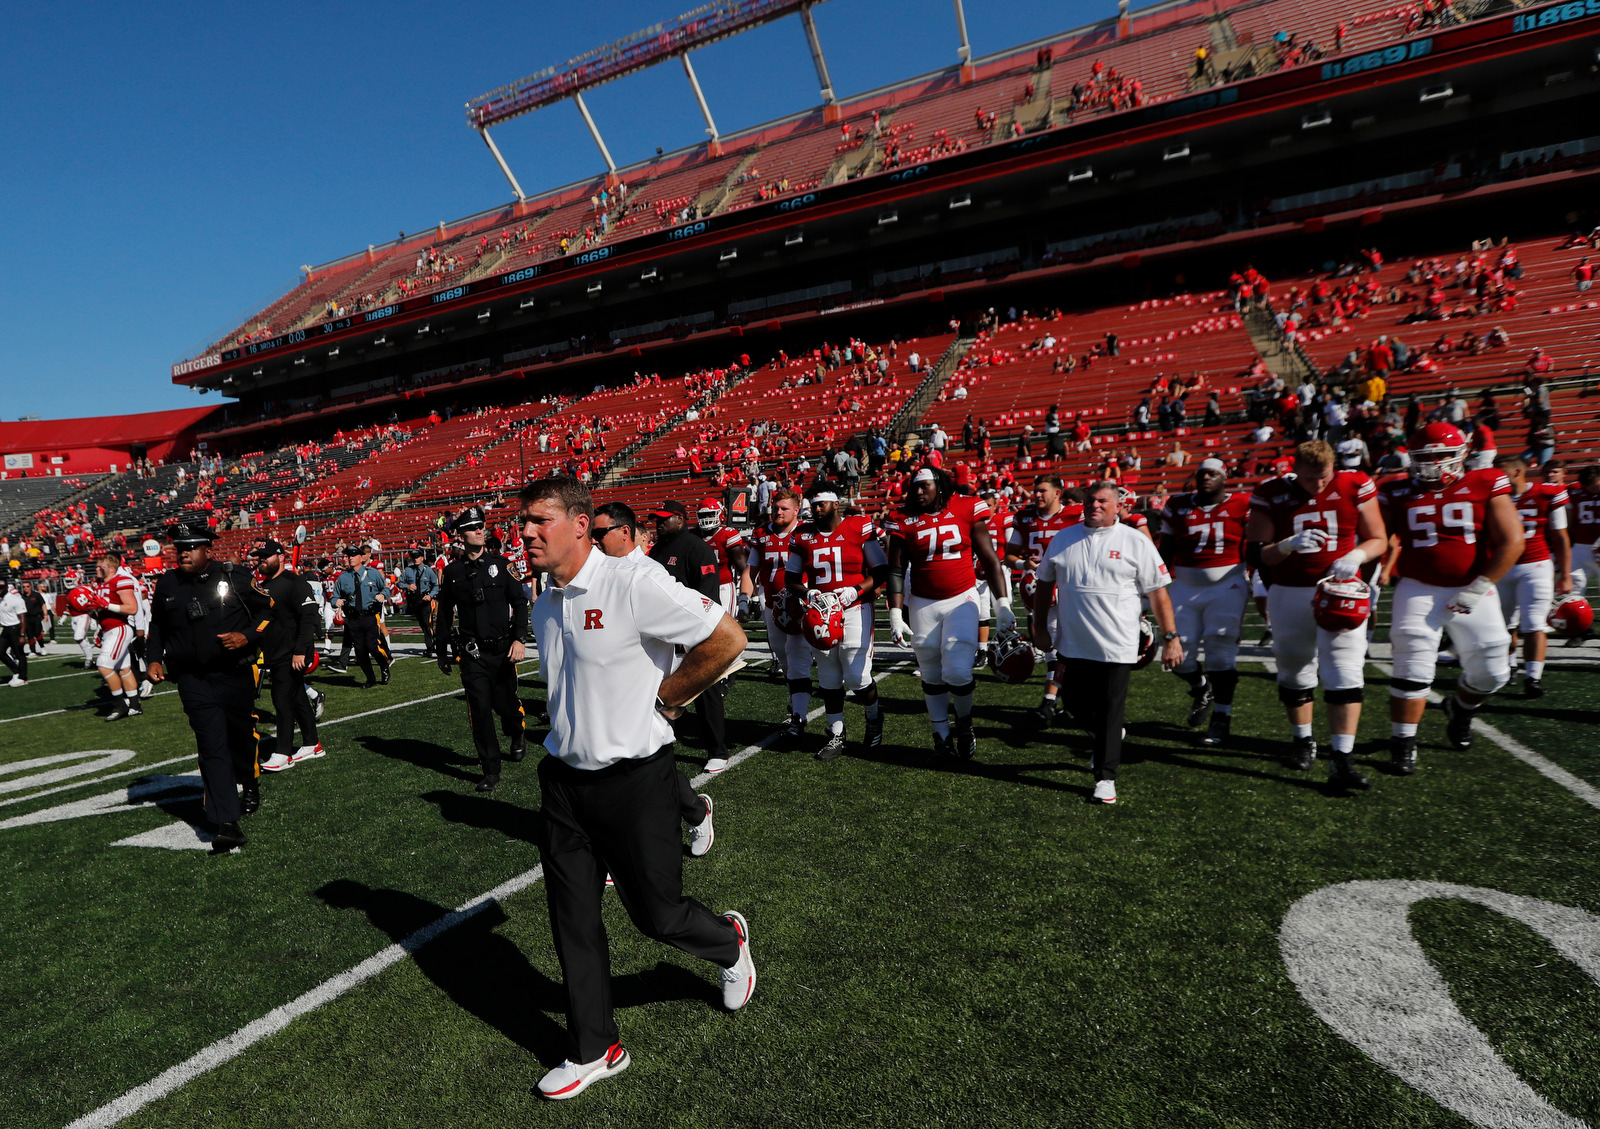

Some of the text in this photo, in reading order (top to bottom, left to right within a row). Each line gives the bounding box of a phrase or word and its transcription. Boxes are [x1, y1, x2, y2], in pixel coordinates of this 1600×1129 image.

[576, 247, 609, 265] 1869
[503, 267, 535, 285] 1869
[434, 287, 463, 303] 1869
[367, 306, 393, 321] 1869
[323, 322, 333, 334] 30
[173, 354, 220, 376] RUTGERS
[732, 492, 748, 514] 4
[1408, 501, 1477, 548] 59
[917, 524, 962, 561] 72
[1188, 521, 1225, 554] 71
[667, 556, 677, 566] R
[1109, 550, 1122, 560] R
[813, 546, 843, 585] 51
[583, 608, 604, 631] R
